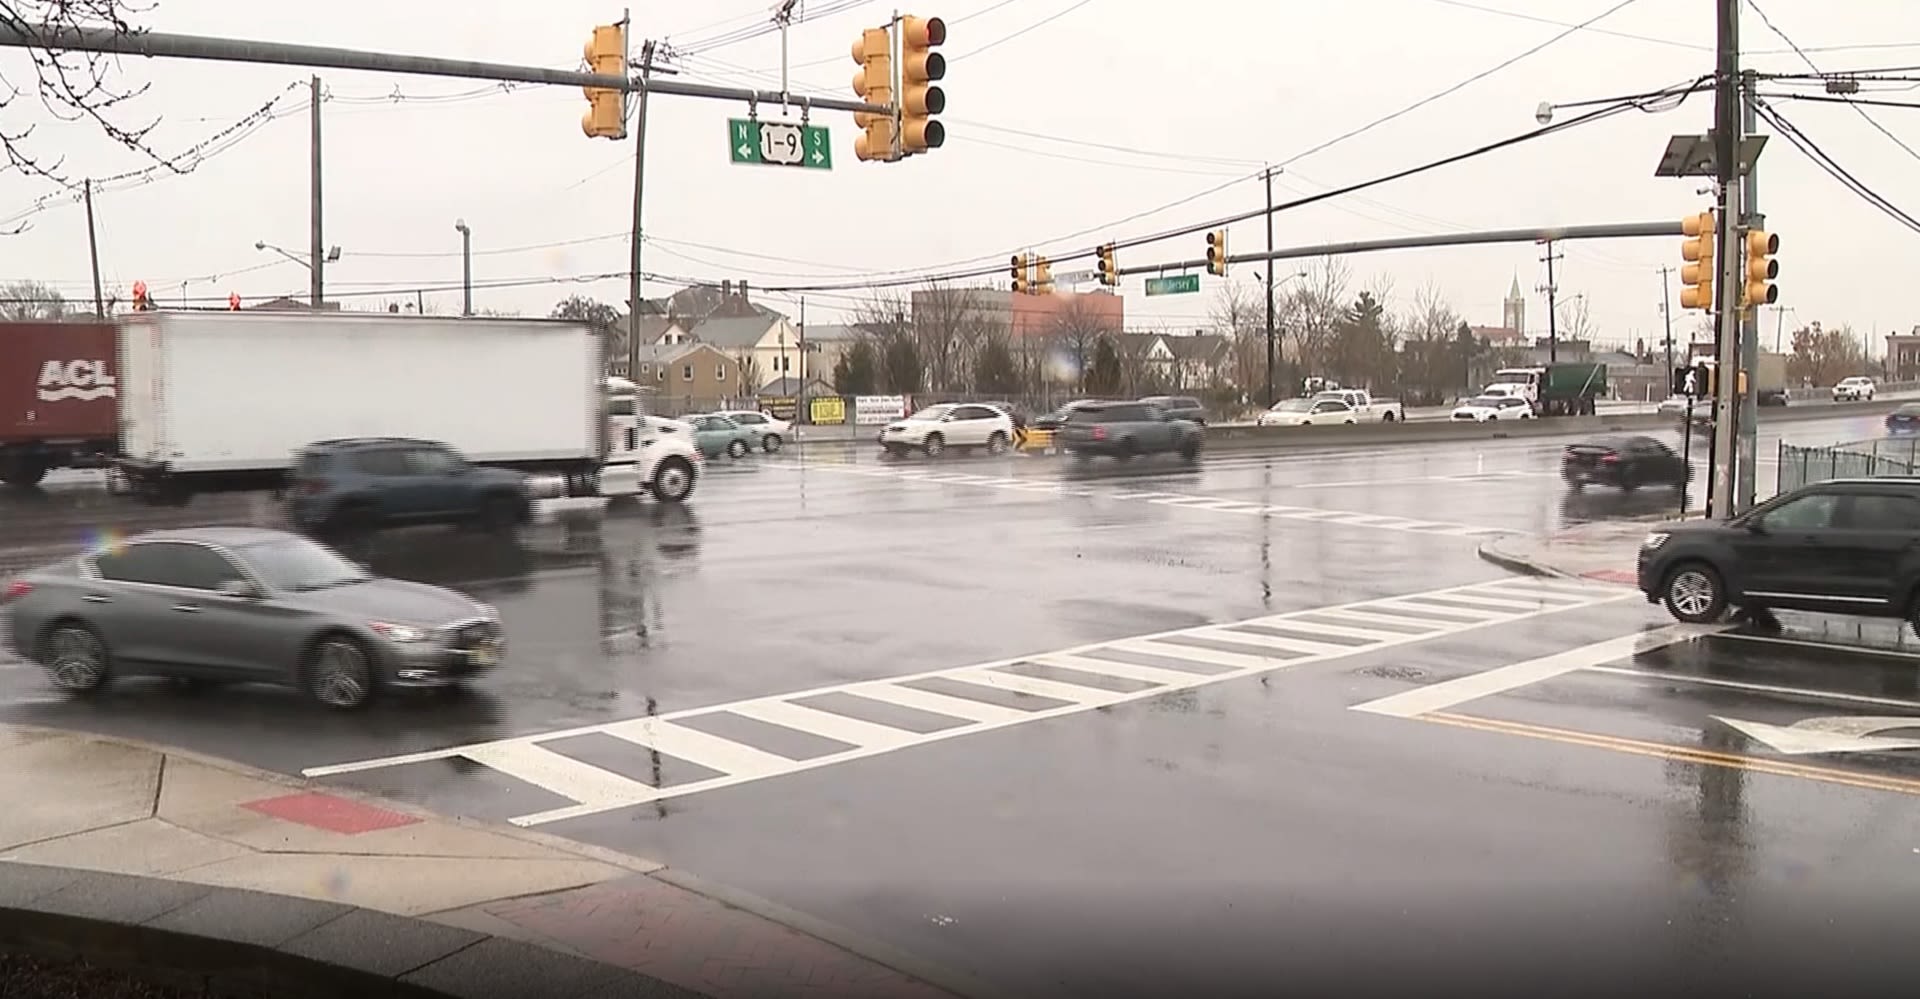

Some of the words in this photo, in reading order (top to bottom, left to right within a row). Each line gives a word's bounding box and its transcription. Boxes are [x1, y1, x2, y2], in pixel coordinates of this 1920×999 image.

[738, 124, 748, 140] N
[813, 131, 821, 146] S
[766, 131, 797, 156] 1-9
[36, 360, 116, 386] ACL
